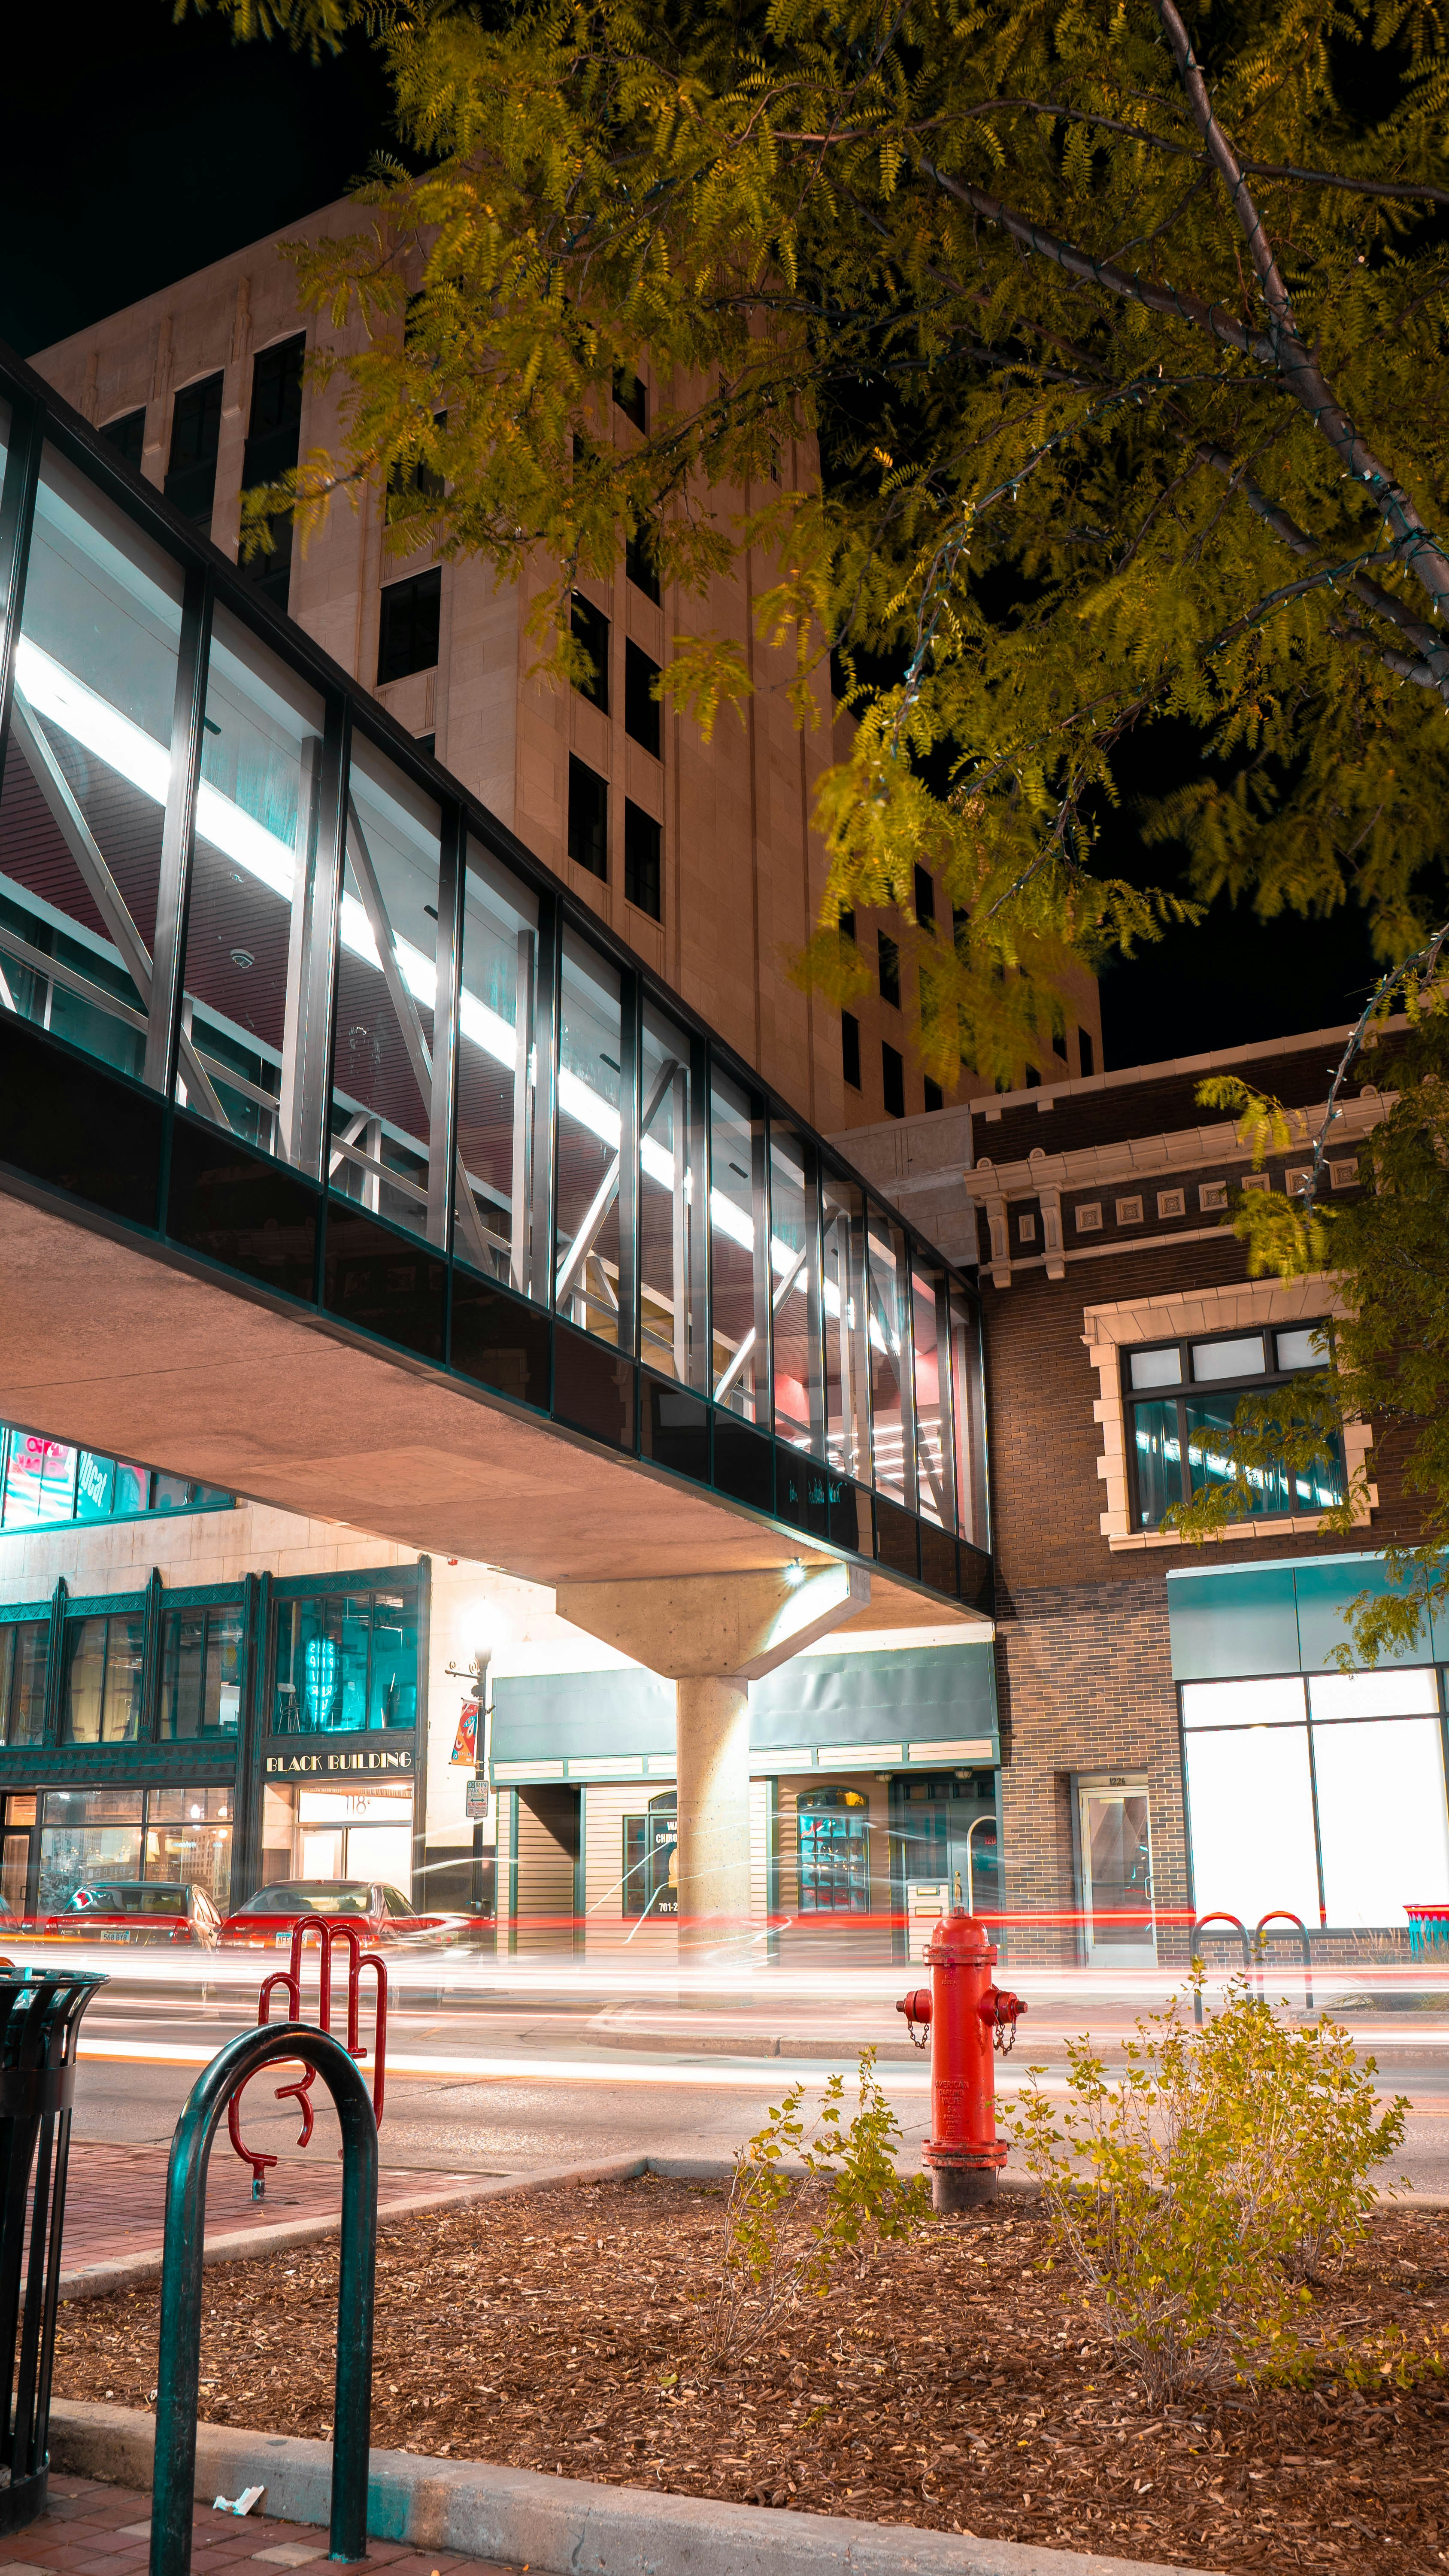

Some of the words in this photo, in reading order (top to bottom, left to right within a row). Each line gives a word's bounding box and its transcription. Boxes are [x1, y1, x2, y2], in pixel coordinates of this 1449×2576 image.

[267, 1756, 322, 1772] BLACK
[328, 1752, 411, 1770] BUILDING
[346, 1795, 366, 1814] 118
[985, 1835, 996, 1844] 120
[942, 2096, 962, 2105] VALVE
